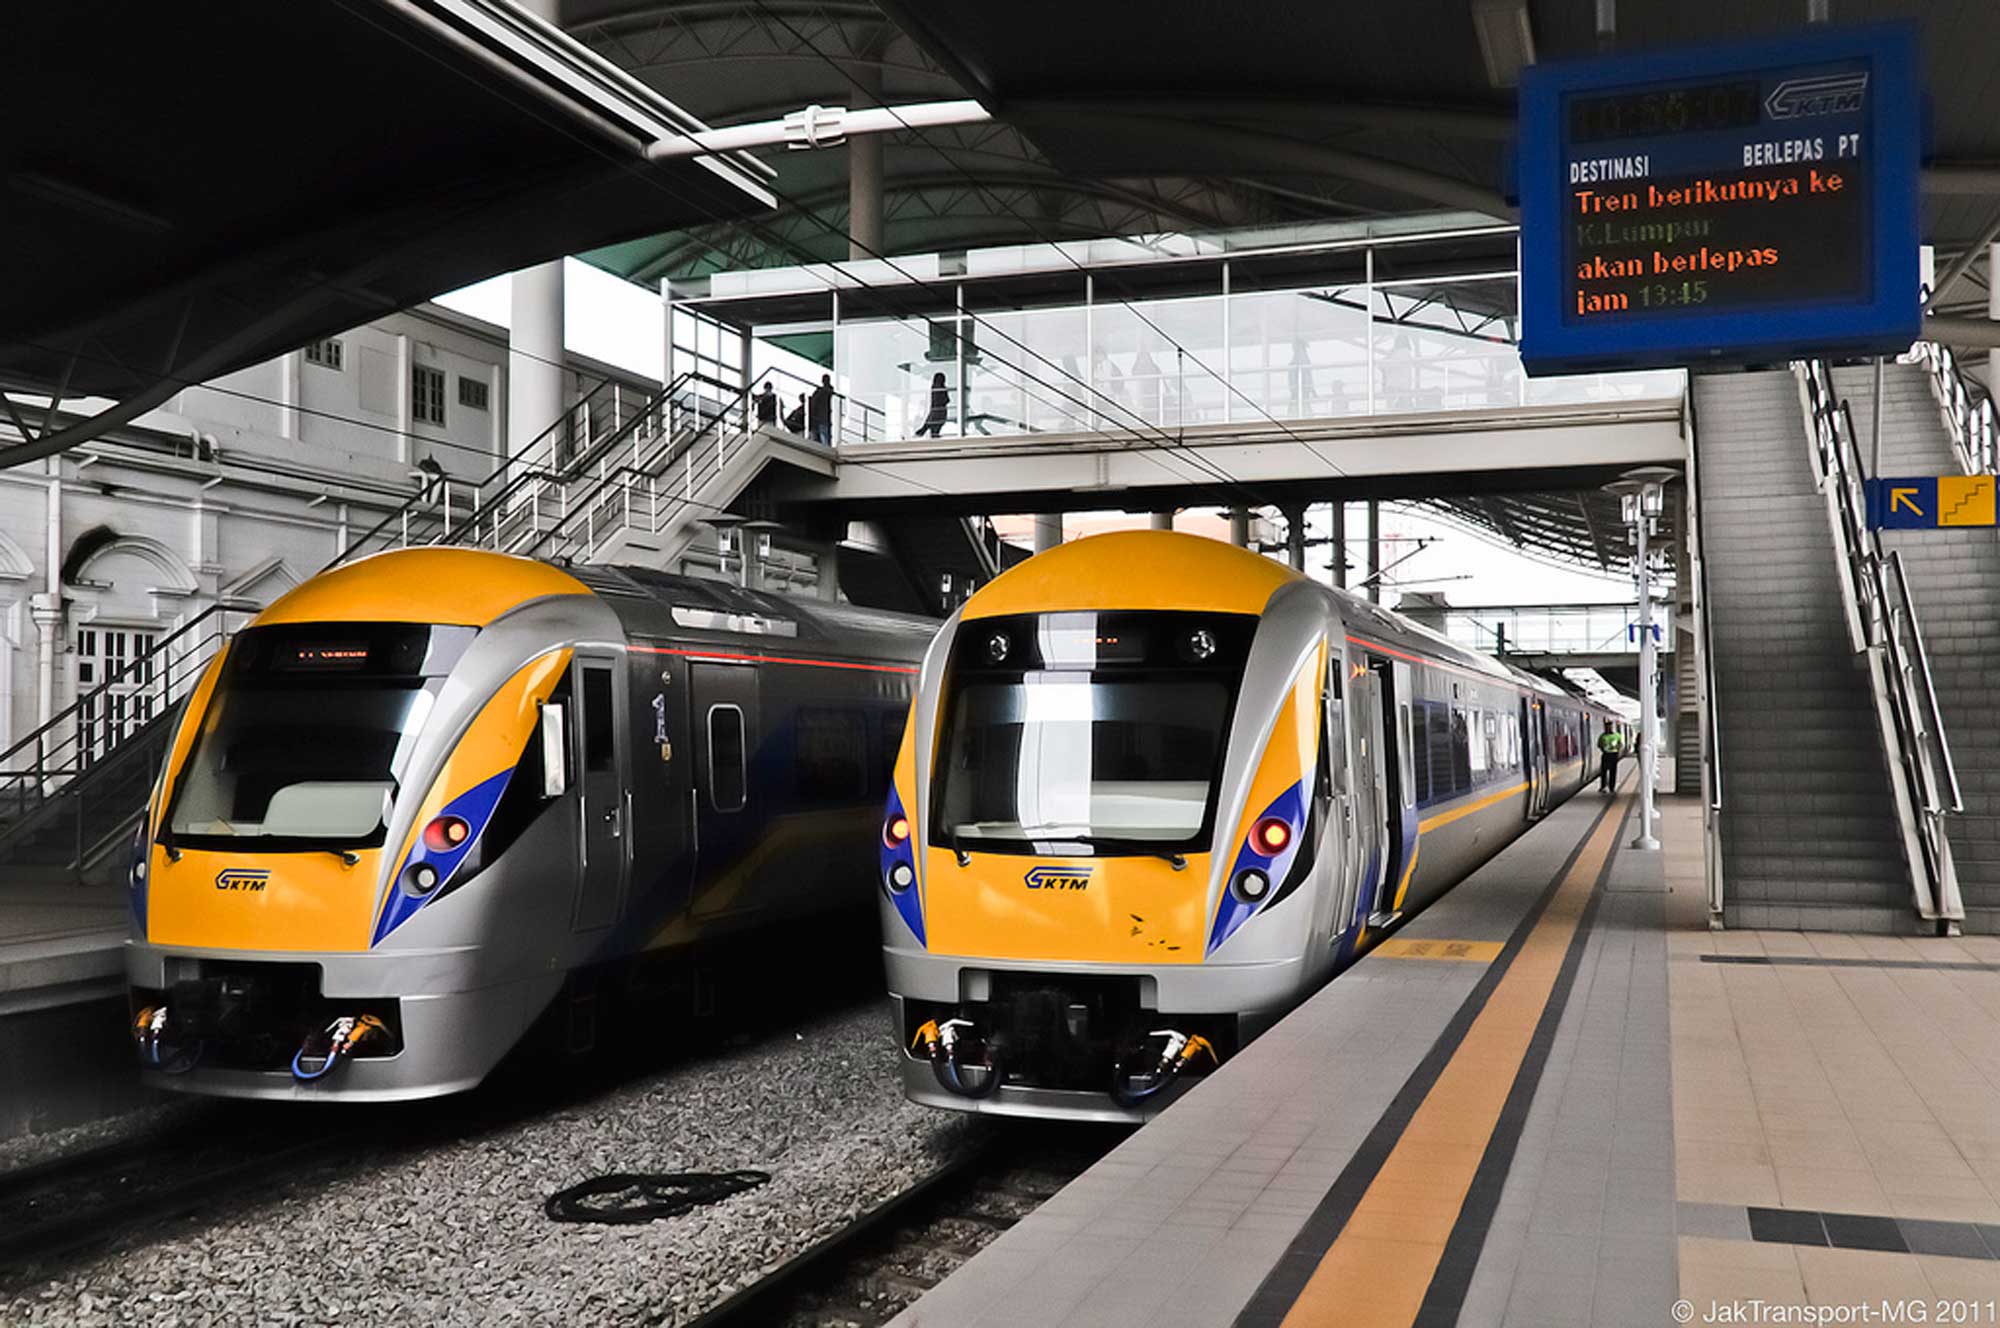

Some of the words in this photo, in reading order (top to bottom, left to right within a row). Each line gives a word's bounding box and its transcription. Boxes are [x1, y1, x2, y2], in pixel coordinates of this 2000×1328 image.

[1570, 155, 1650, 183] DESTINASI
[1743, 138, 1824, 168] BERLEPAS
[1838, 134, 1860, 157] PT
[1575, 190, 1638, 214] Tren
[1649, 177, 1799, 208] berikutnya
[1810, 170, 1843, 193] ke
[1577, 255, 1643, 279] akan
[1654, 246, 1779, 275] berlepas
[1577, 290, 1629, 315] jam
[1640, 281, 1707, 306] 13:45
